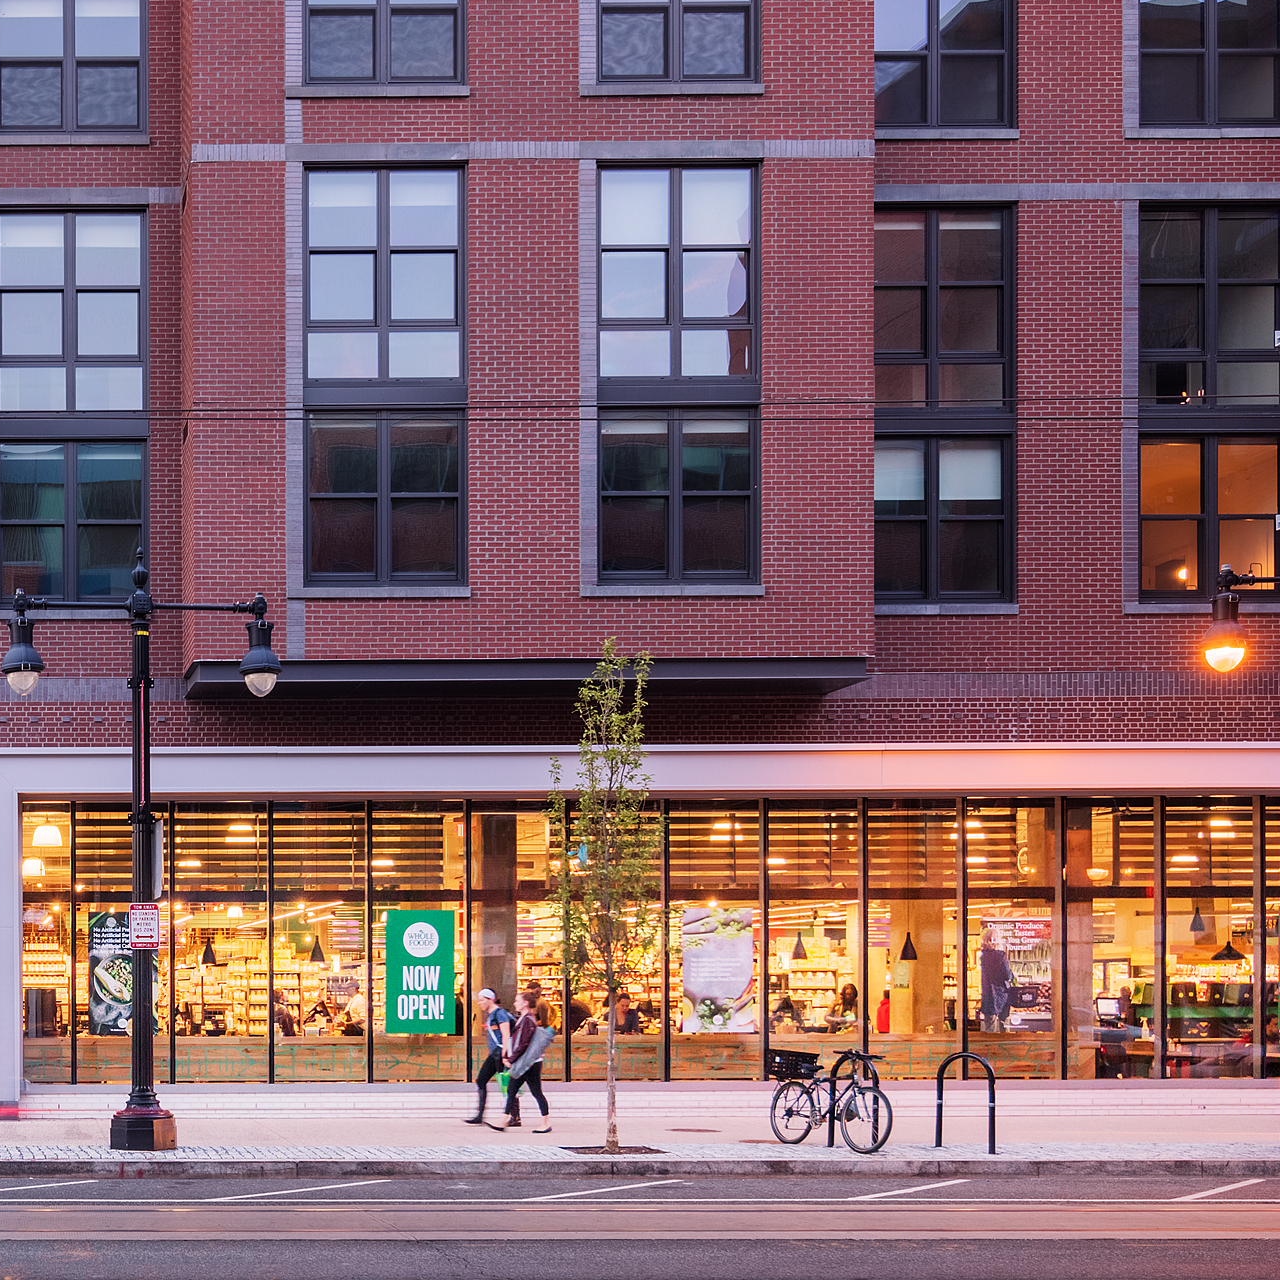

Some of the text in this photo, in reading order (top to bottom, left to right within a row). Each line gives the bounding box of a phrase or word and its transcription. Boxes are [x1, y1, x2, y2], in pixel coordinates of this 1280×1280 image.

[407, 931, 435, 940] WHOLE
[402, 965, 441, 992] NOW
[397, 994, 445, 1020] OPEN!
